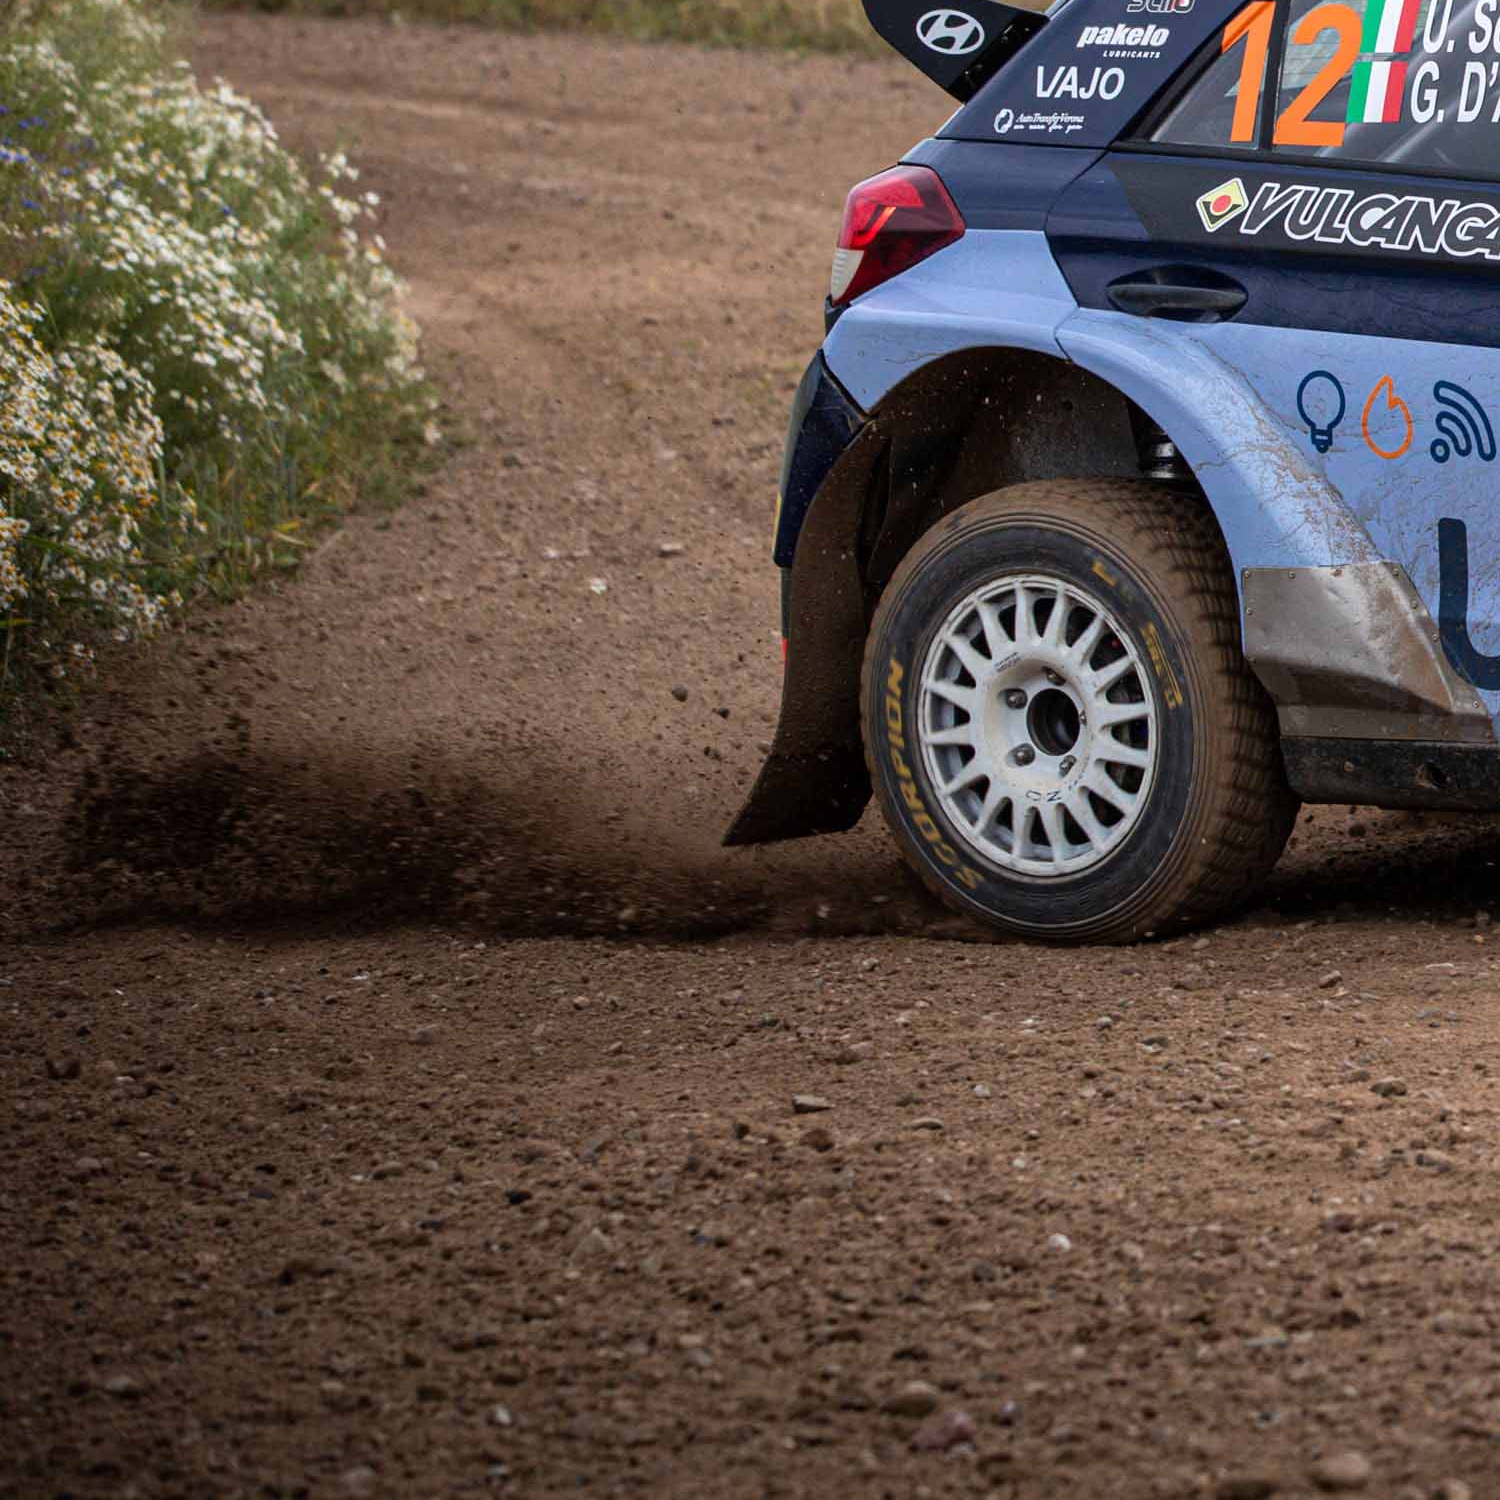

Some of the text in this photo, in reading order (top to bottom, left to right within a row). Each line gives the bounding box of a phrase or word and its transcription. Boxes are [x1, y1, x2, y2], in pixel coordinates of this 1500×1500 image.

[1077, 23, 1170, 48] pakelo
[1103, 50, 1161, 59] LUBRICANTS
[1036, 66, 1125, 100] VAJO
[1221, 0, 1363, 147] 12
[1411, 61, 1445, 124] G.
[886, 657, 987, 890] SCORPION
